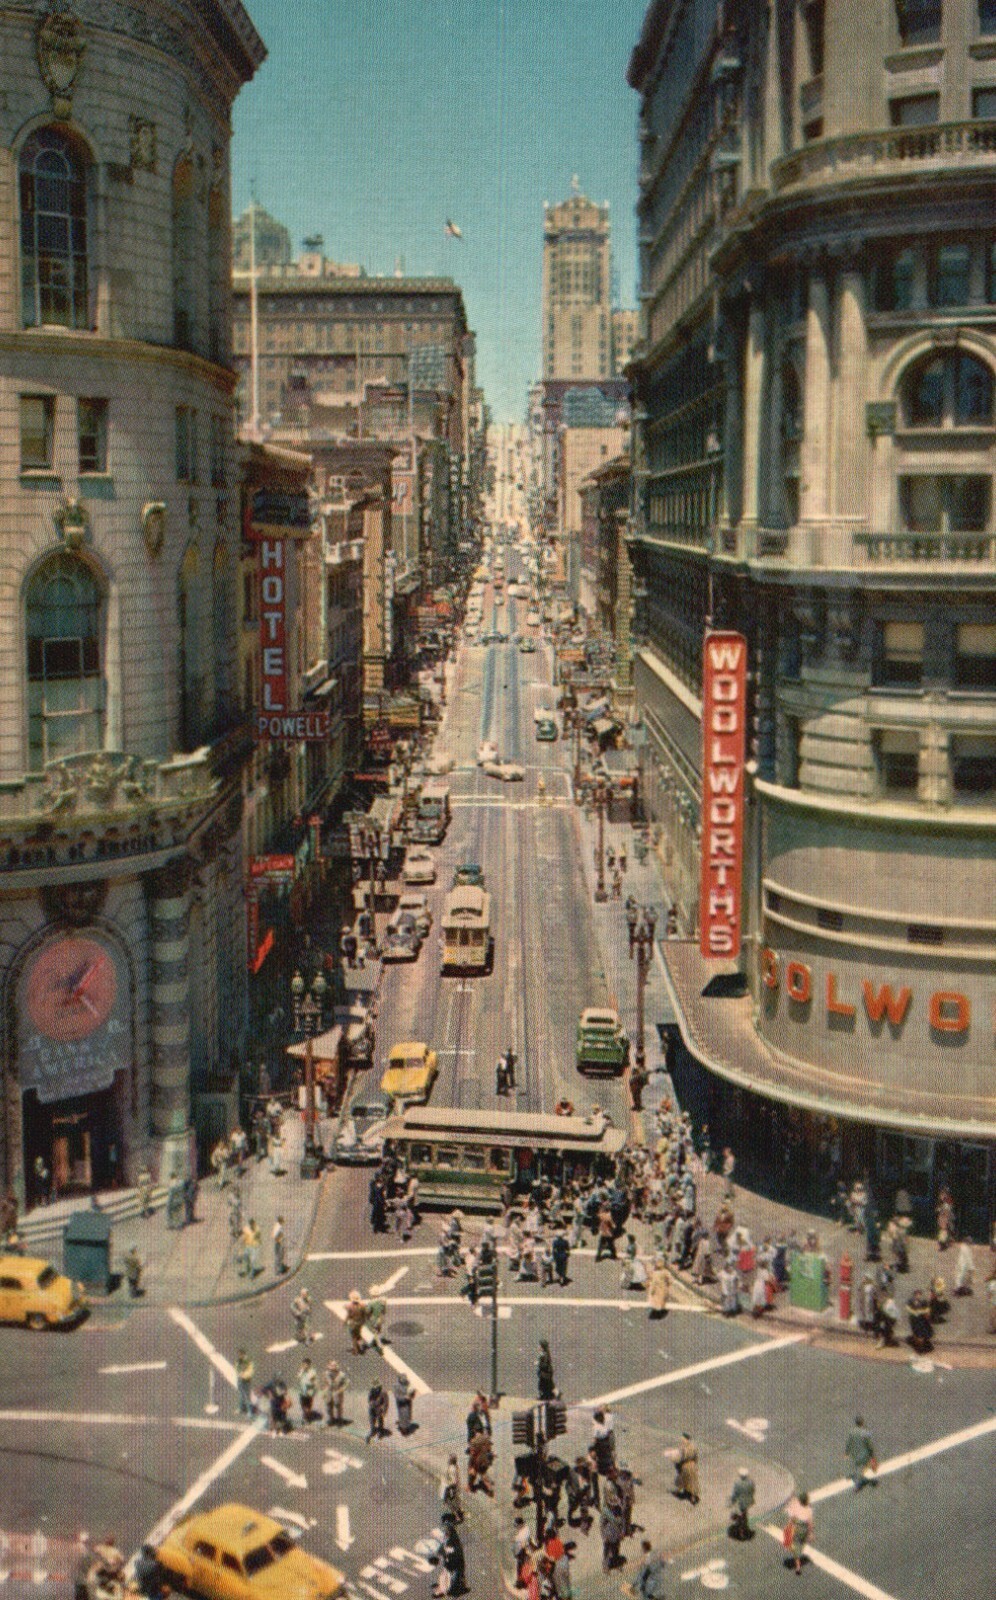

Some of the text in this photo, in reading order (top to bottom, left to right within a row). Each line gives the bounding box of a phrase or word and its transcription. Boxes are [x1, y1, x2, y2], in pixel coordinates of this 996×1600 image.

[261, 540, 284, 711] HOTEL
[258, 716, 326, 737] POWELL
[708, 641, 741, 952] WOOLWORTH'S
[760, 948, 996, 1033] OOLWO
